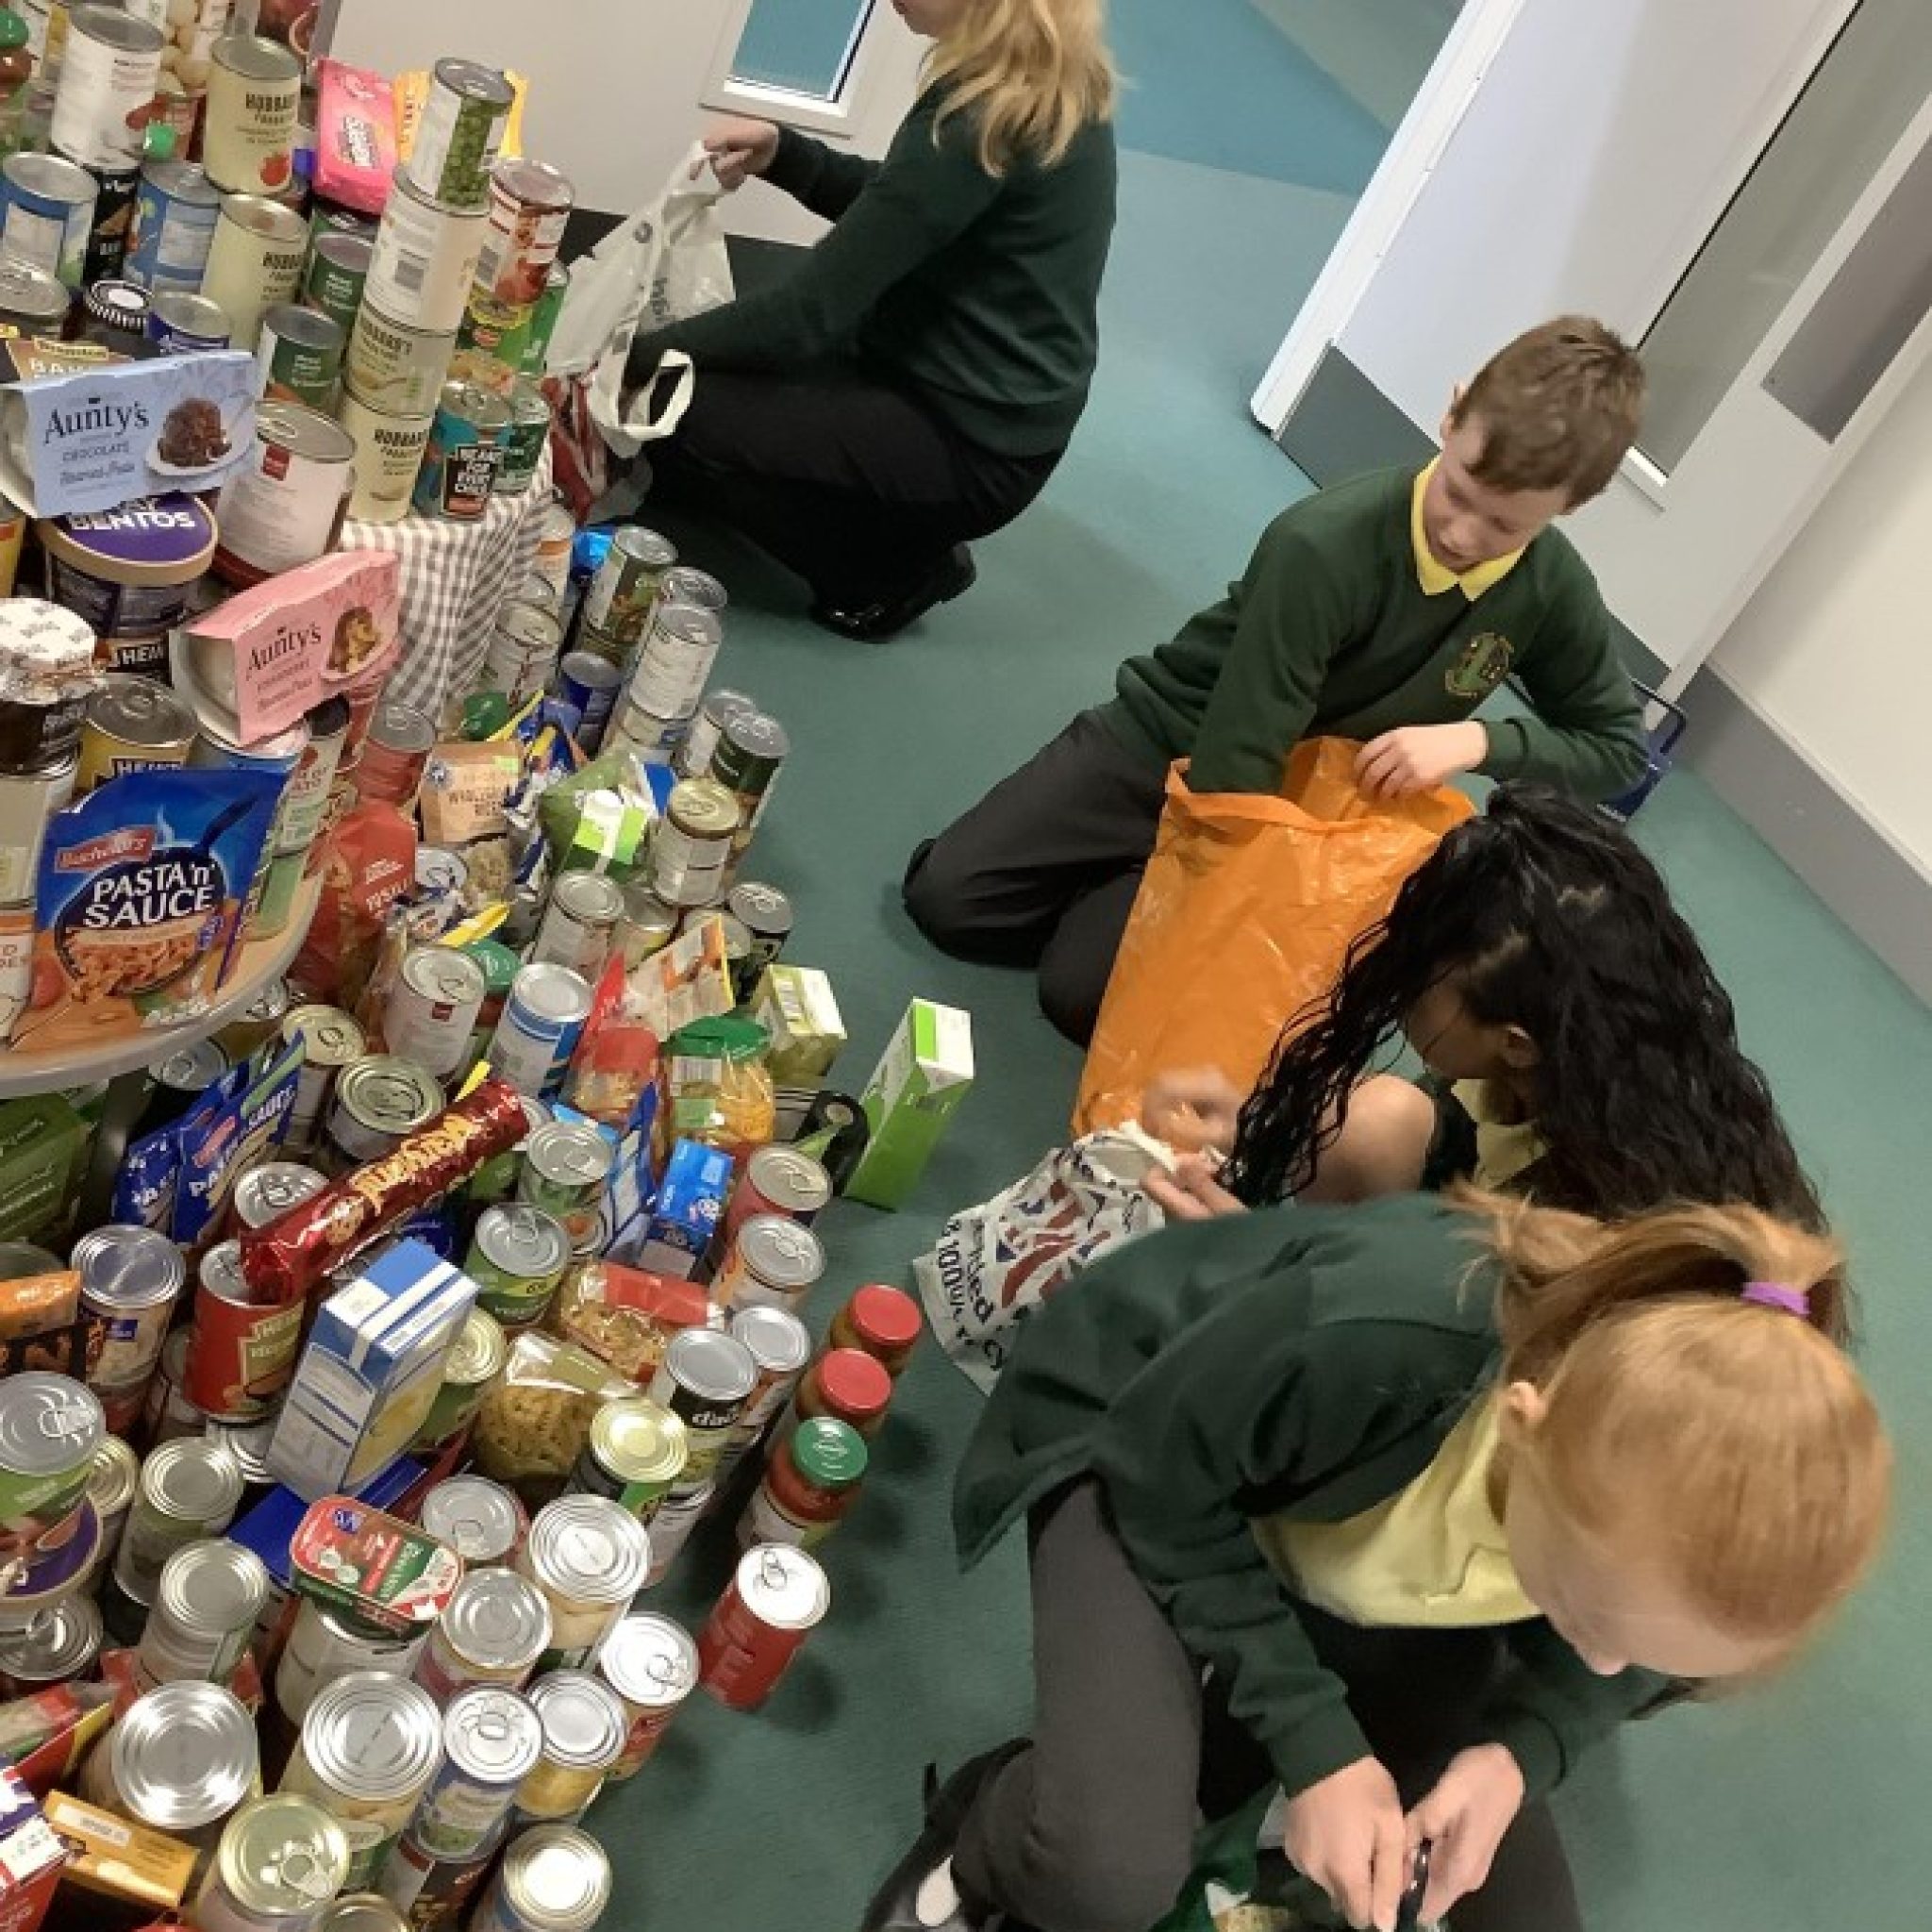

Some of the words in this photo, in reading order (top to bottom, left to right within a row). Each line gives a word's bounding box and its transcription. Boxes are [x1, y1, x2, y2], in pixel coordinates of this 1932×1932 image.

[44, 400, 150, 444] Aunty's
[68, 510, 196, 530] BENTOS
[121, 642, 166, 662] HEIN
[245, 620, 322, 682] Aunty's
[93, 860, 187, 903] PASTA
[82, 884, 216, 928] SAUCE
